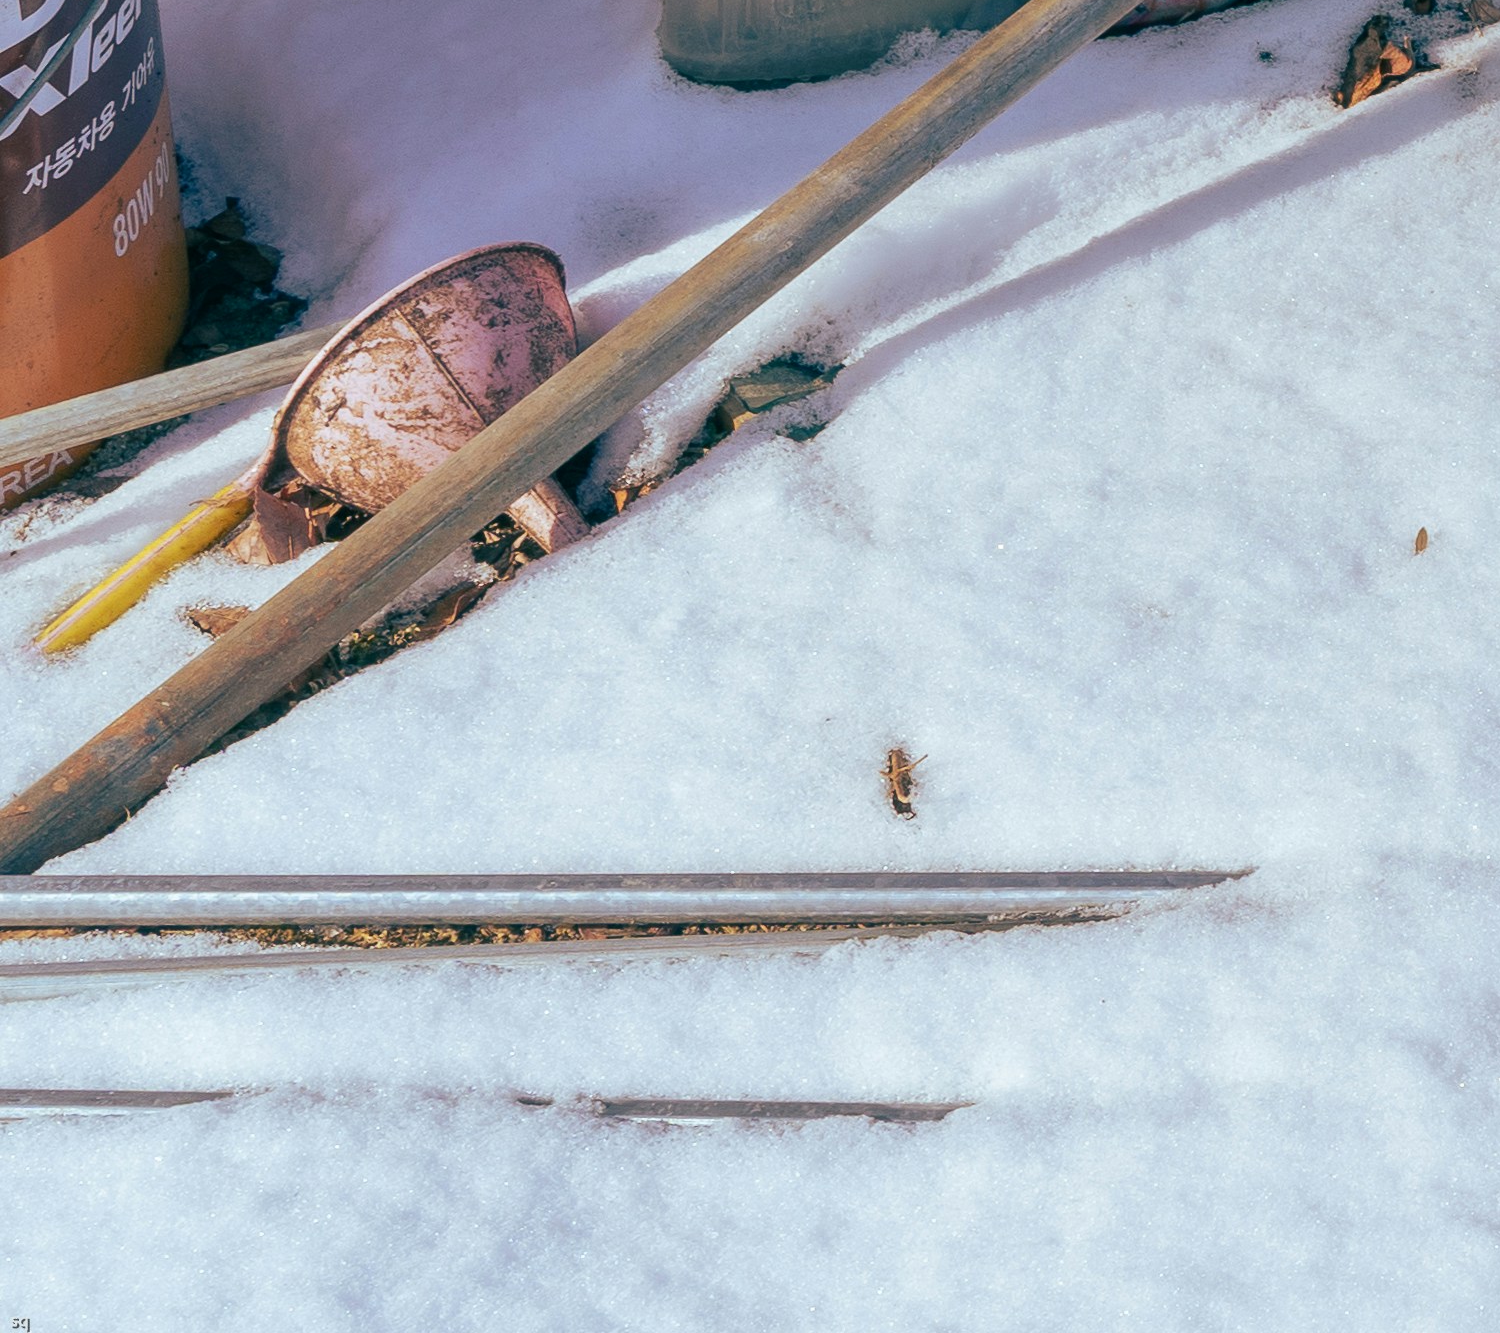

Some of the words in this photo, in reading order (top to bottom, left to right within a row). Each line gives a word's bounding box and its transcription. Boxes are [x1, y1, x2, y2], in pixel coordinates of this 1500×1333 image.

[22, 99, 118, 196] 자동차용
[121, 35, 156, 107] 기어유
[112, 177, 155, 260] 80W
[155, 140, 171, 199] 90
